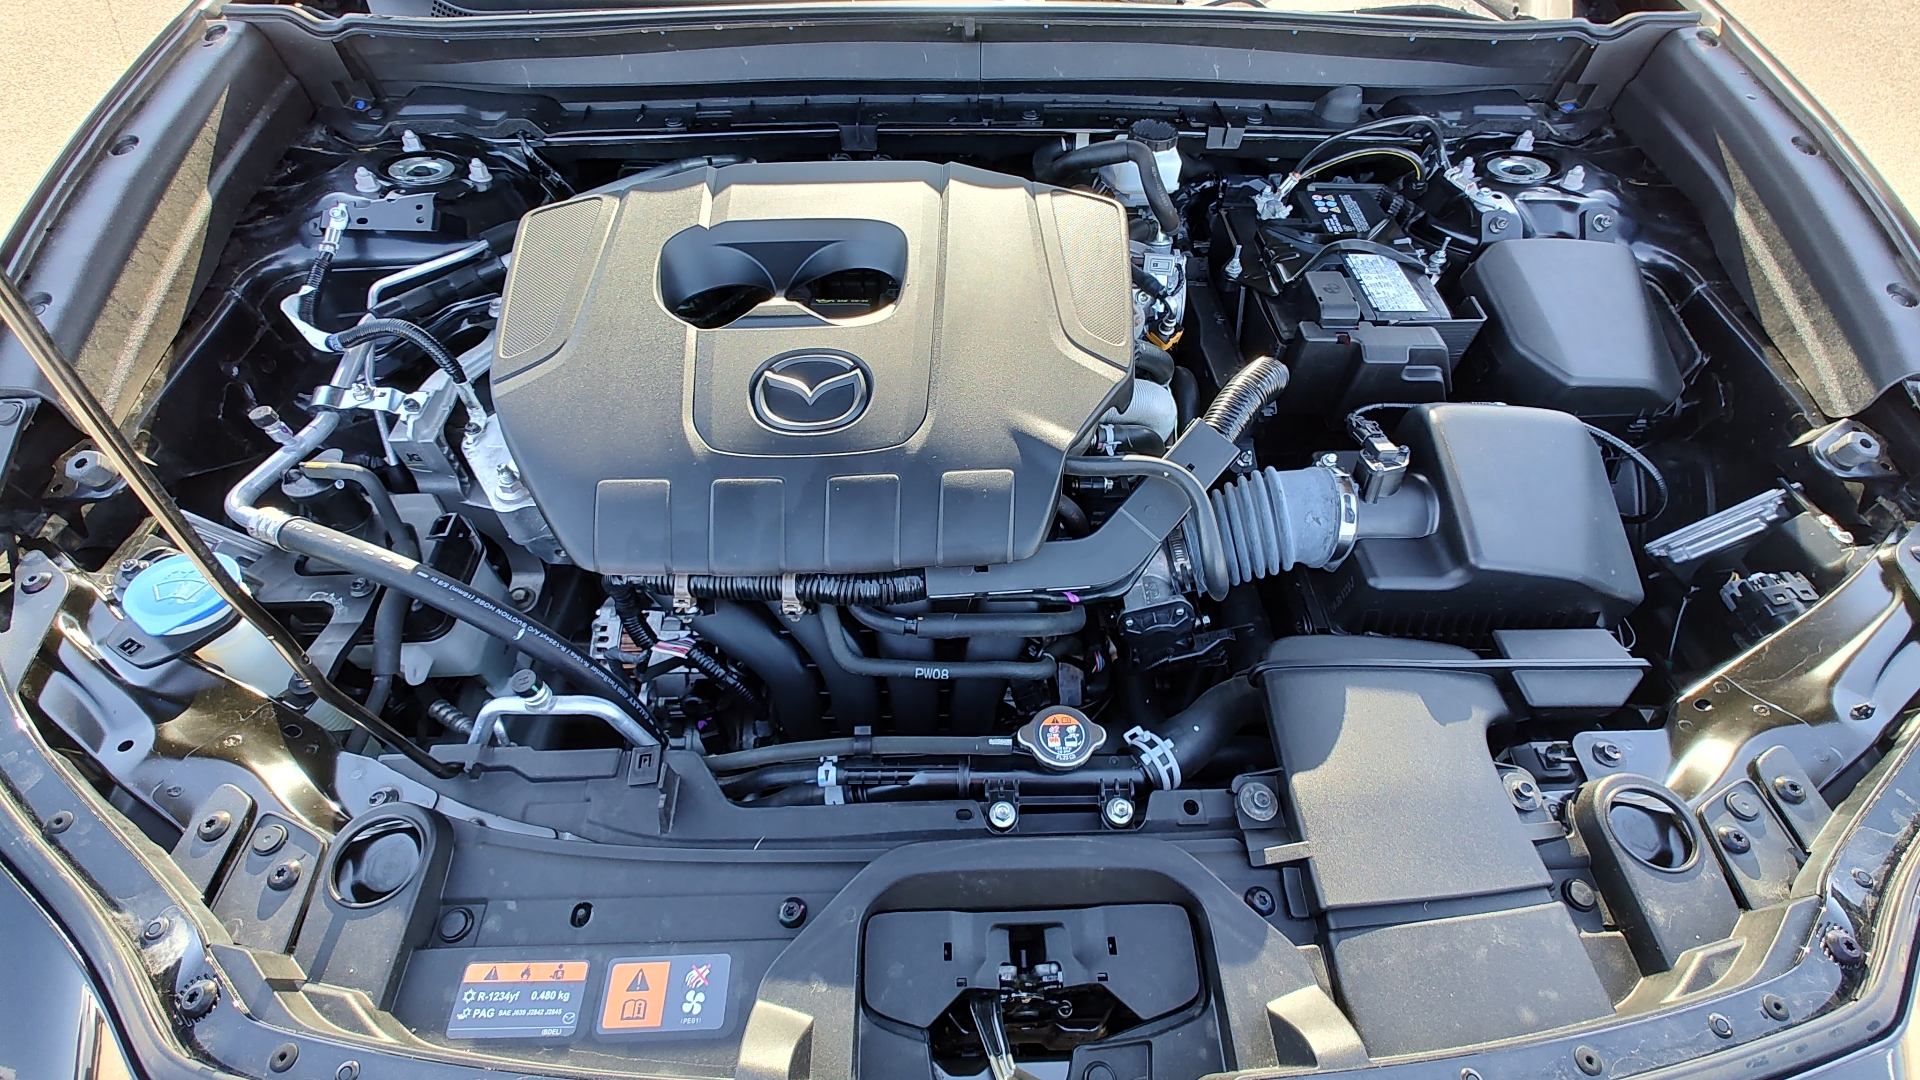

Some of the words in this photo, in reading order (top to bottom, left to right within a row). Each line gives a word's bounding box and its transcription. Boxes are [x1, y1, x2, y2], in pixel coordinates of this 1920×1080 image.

[449, 584, 476, 600] (16mm)
[473, 597, 496, 612] HOSE
[495, 608, 528, 629] SUCTION
[527, 626, 540, 636] A/C
[539, 632, 567, 652] R-1234yf
[915, 667, 949, 679] PW08
[627, 696, 650, 720] GALAXY
[477, 991, 521, 1004] R-1234yf
[531, 990, 557, 1001] 0.480
[557, 990, 571, 1002] kg
[472, 1008, 495, 1018] PAG
[527, 1008, 545, 1016] J2842
[544, 1008, 563, 1016] J2845
